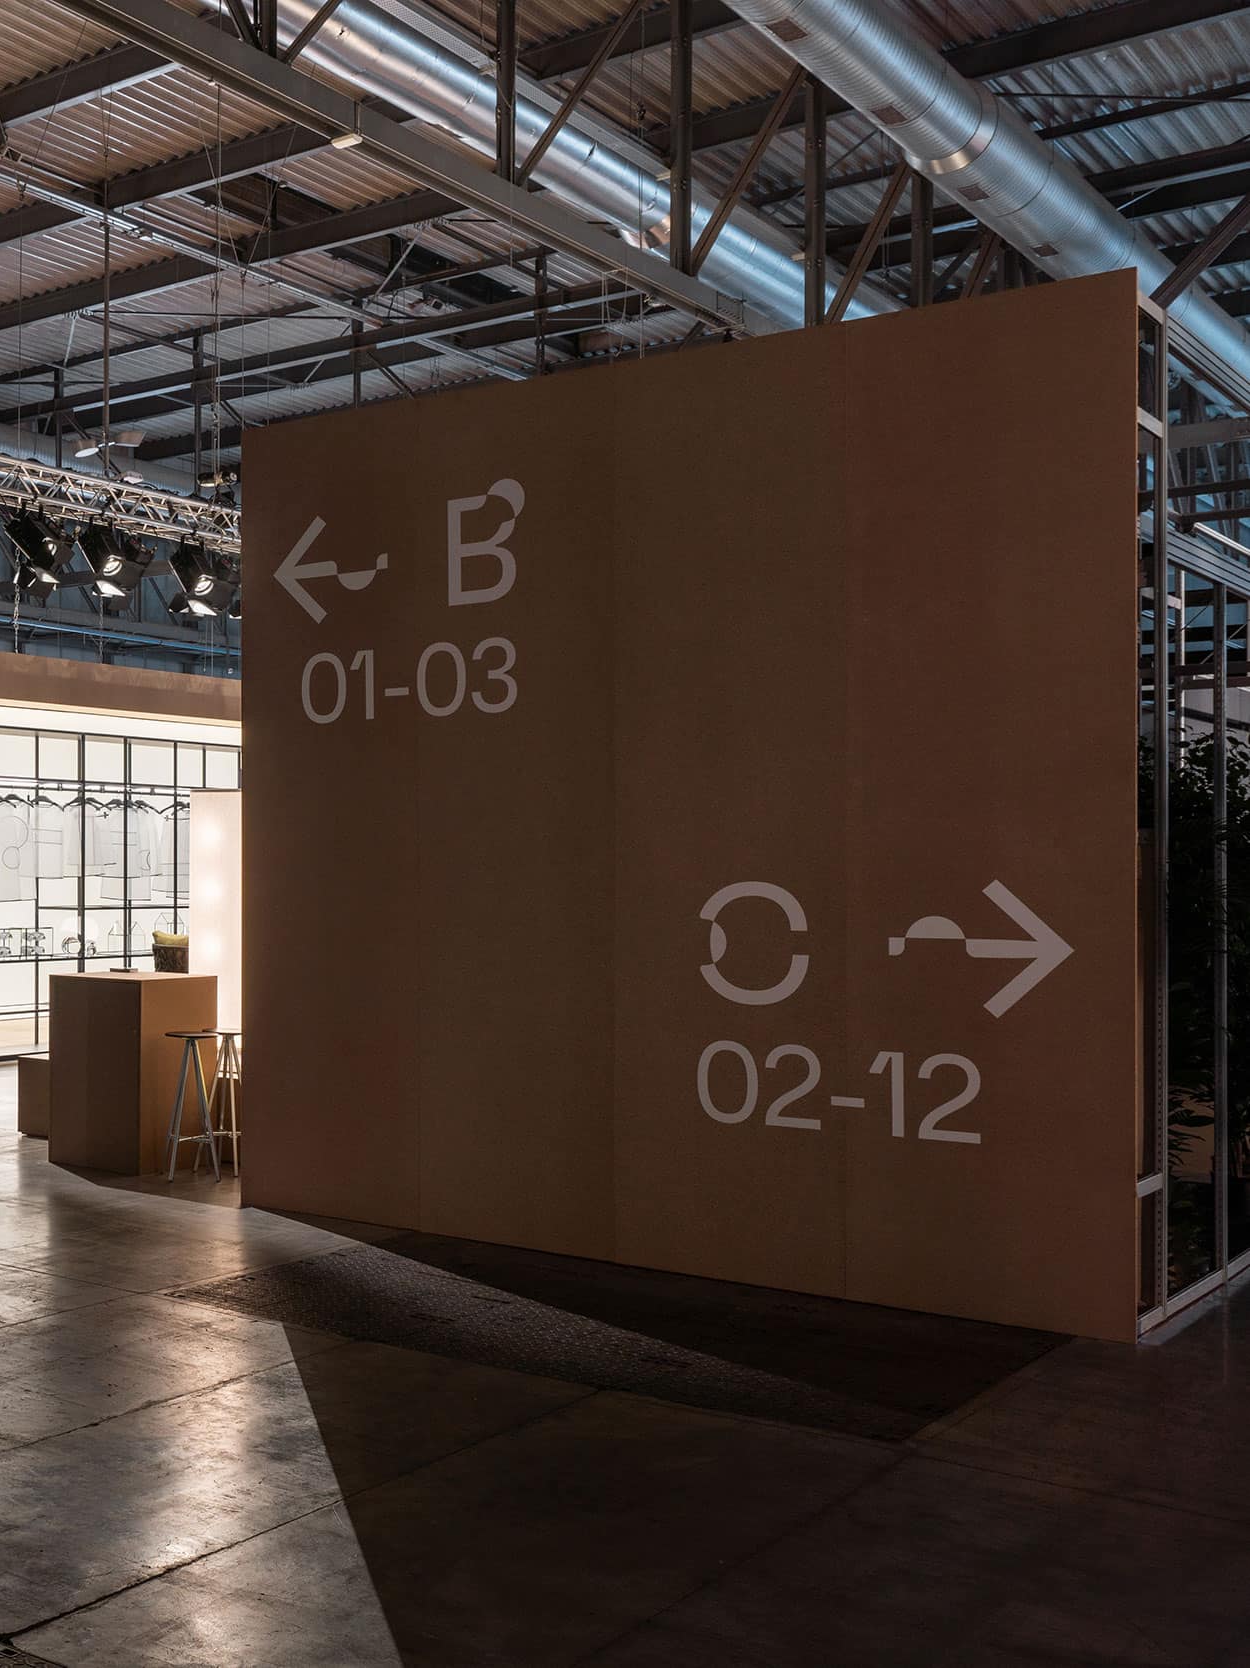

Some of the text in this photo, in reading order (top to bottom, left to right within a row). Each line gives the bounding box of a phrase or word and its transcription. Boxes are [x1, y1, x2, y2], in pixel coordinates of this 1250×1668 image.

[447, 478, 526, 606] B
[301, 636, 519, 725] 01-03
[696, 1040, 982, 1145] 02-12
